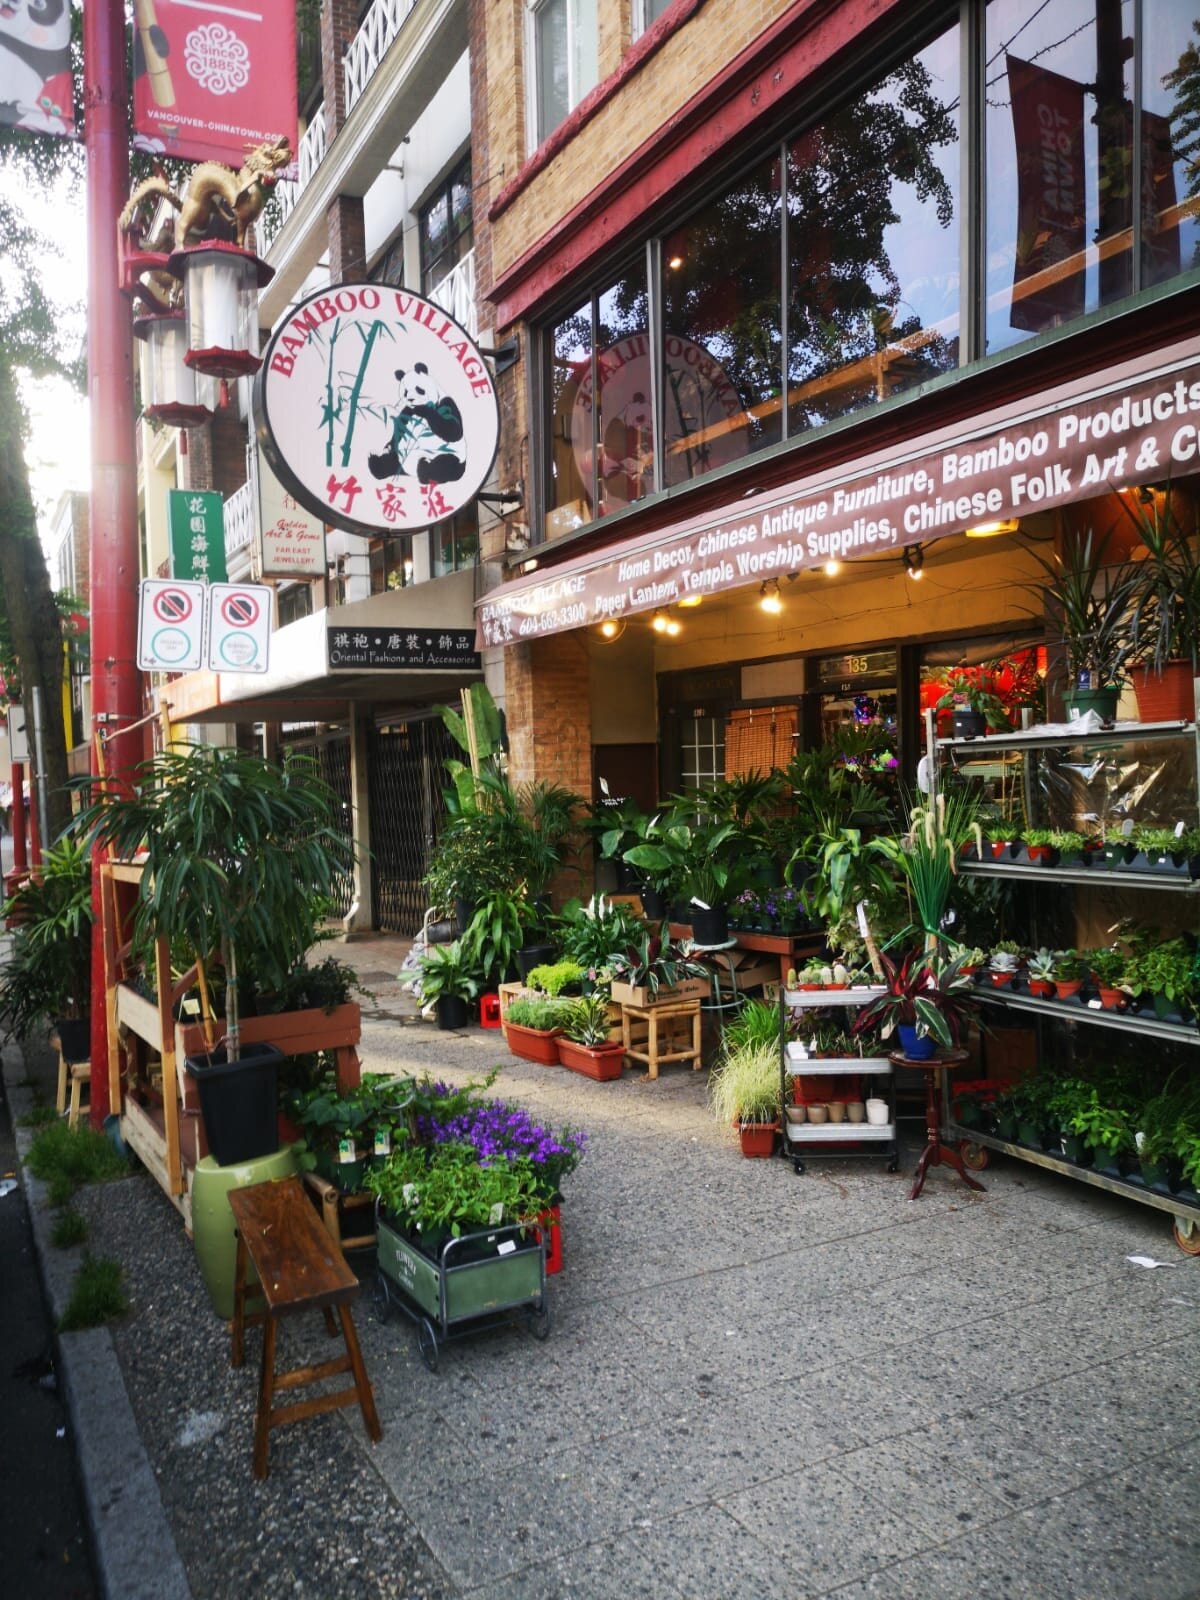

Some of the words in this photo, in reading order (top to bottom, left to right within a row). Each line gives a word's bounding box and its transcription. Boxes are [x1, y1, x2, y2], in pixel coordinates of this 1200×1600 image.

[203, 57, 235, 73] 1885
[270, 288, 381, 379] BAMBOO
[394, 292, 492, 398] VILLAGE
[618, 559, 650, 582] Home
[653, 546, 695, 573] Decor,
[698, 523, 758, 557] Chinese
[761, 501, 828, 538] Antique
[831, 470, 935, 516] Furniture,
[942, 431, 1049, 484] Bamboo
[1058, 380, 1200, 449] Products
[276, 518, 309, 529] Golden
[594, 591, 626, 616] Paper
[682, 561, 735, 592] Temple
[736, 541, 804, 577] Worship
[806, 517, 897, 557] Supplies,
[903, 487, 1003, 534] Chinese
[1010, 463, 1073, 505] Folk
[1079, 446, 1128, 488] Art
[1134, 436, 1161, 472] &
[1171, 425, 1200, 462] C
[264, 529, 283, 539] Art
[295, 530, 321, 542] Gems
[330, 650, 367, 664] Oriental
[369, 651, 406, 664] Fashions
[408, 651, 424, 663] and
[426, 652, 476, 665] Accessories
